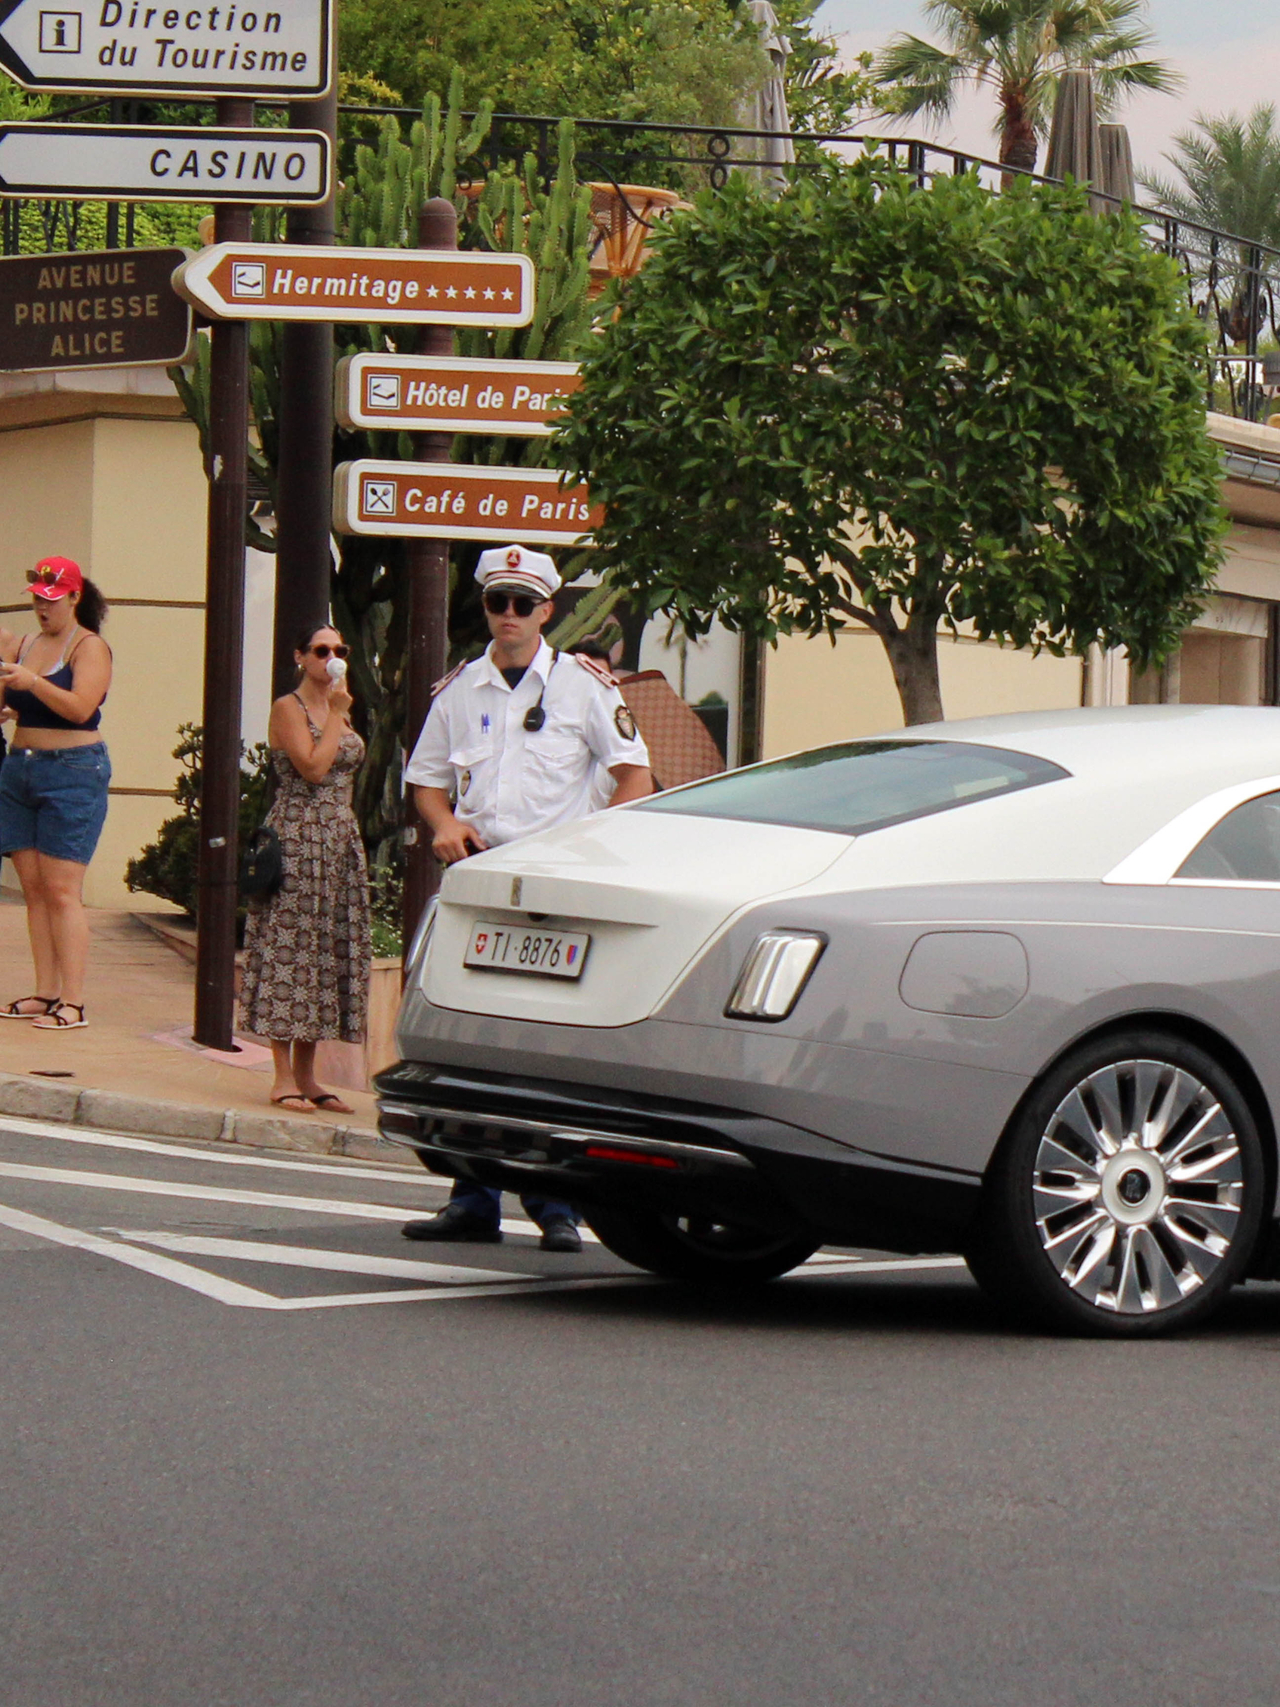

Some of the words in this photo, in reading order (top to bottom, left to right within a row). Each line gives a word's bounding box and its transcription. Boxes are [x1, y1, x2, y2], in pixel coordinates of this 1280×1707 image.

[99, 0, 282, 33] Direction
[98, 39, 137, 66] du
[154, 39, 308, 72] Tourisme
[150, 149, 306, 181] CASINO
[37, 261, 136, 290] AVENUE
[272, 269, 420, 305] Hermitage
[14, 294, 159, 325] PRINCESSE
[50, 331, 125, 357] ALICE
[405, 381, 470, 408] Hôtel
[476, 386, 505, 409] de
[404, 488, 466, 515] Café
[478, 494, 509, 517] de
[520, 495, 591, 521] Paris
